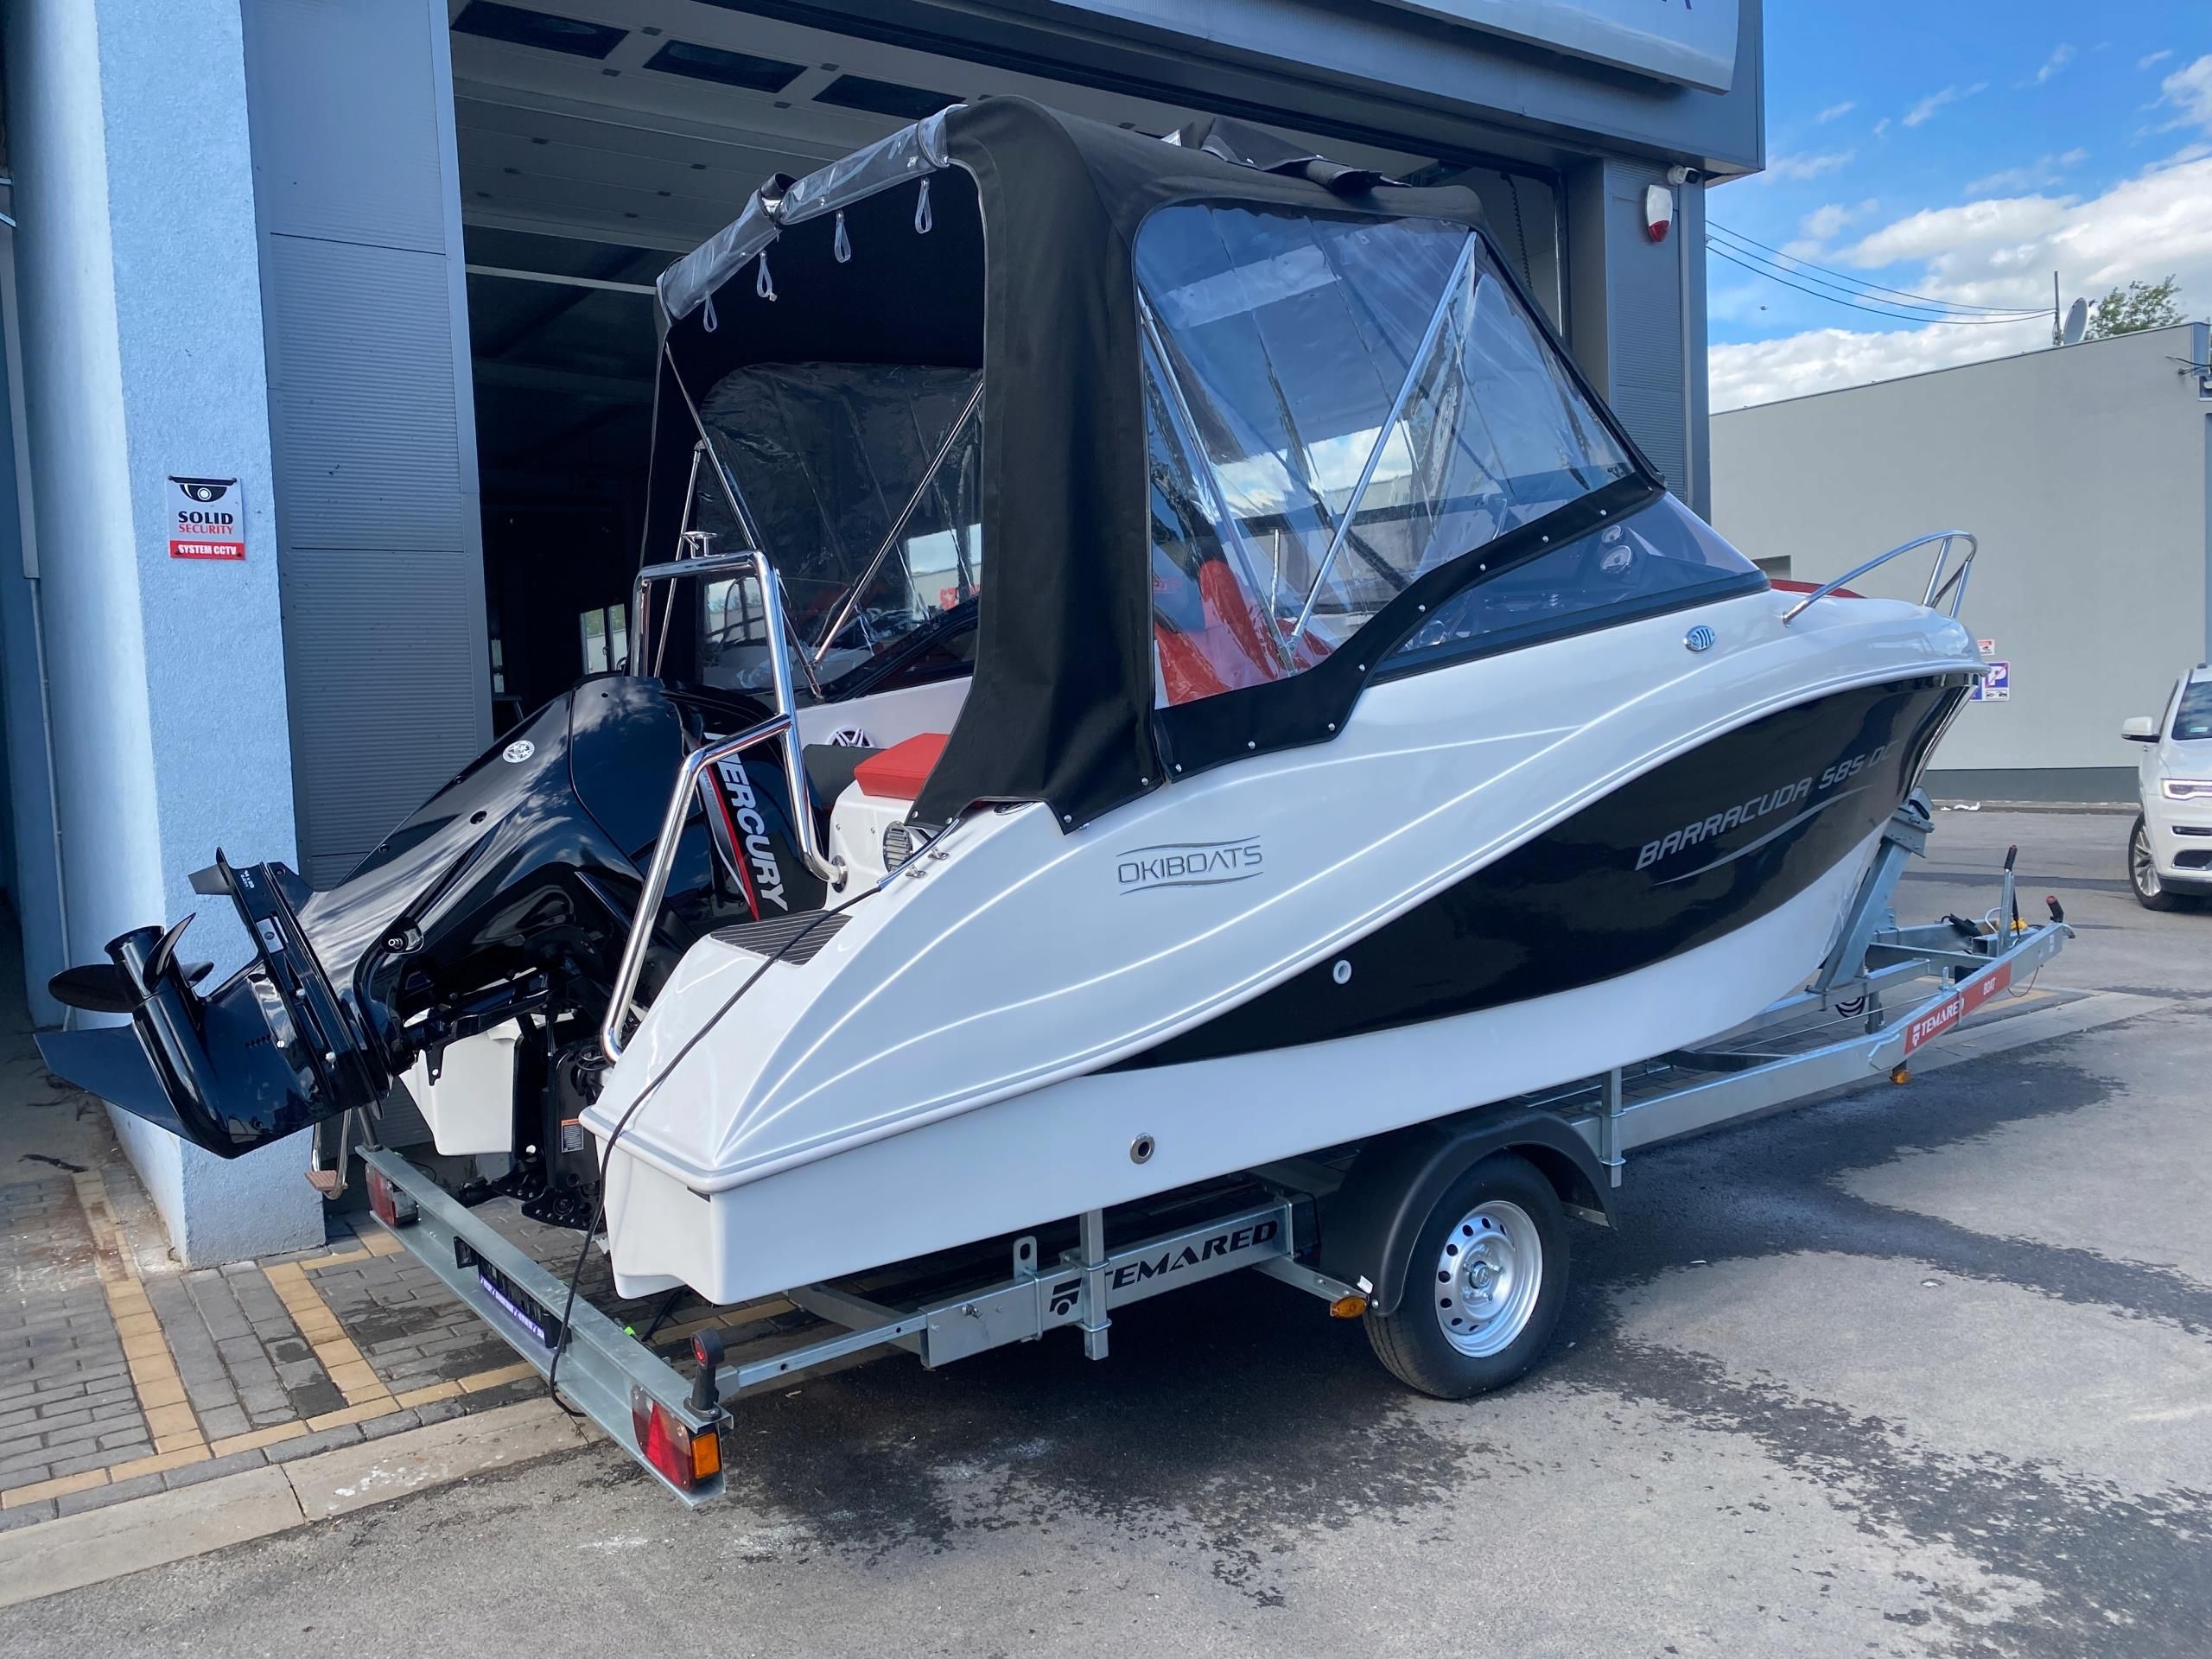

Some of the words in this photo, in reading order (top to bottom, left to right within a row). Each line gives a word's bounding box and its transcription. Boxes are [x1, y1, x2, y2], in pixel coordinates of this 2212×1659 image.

[178, 511, 233, 524] SOLID
[179, 524, 233, 535] SECURITY
[178, 544, 212, 554] SYSTEM
[213, 545, 237, 555] CCTV
[1635, 777, 1813, 871] BARRACUDA
[1819, 753, 1866, 789] 585
[1118, 844, 1263, 884] OKIBOATS
[1103, 1220, 1278, 1290] EMARED
